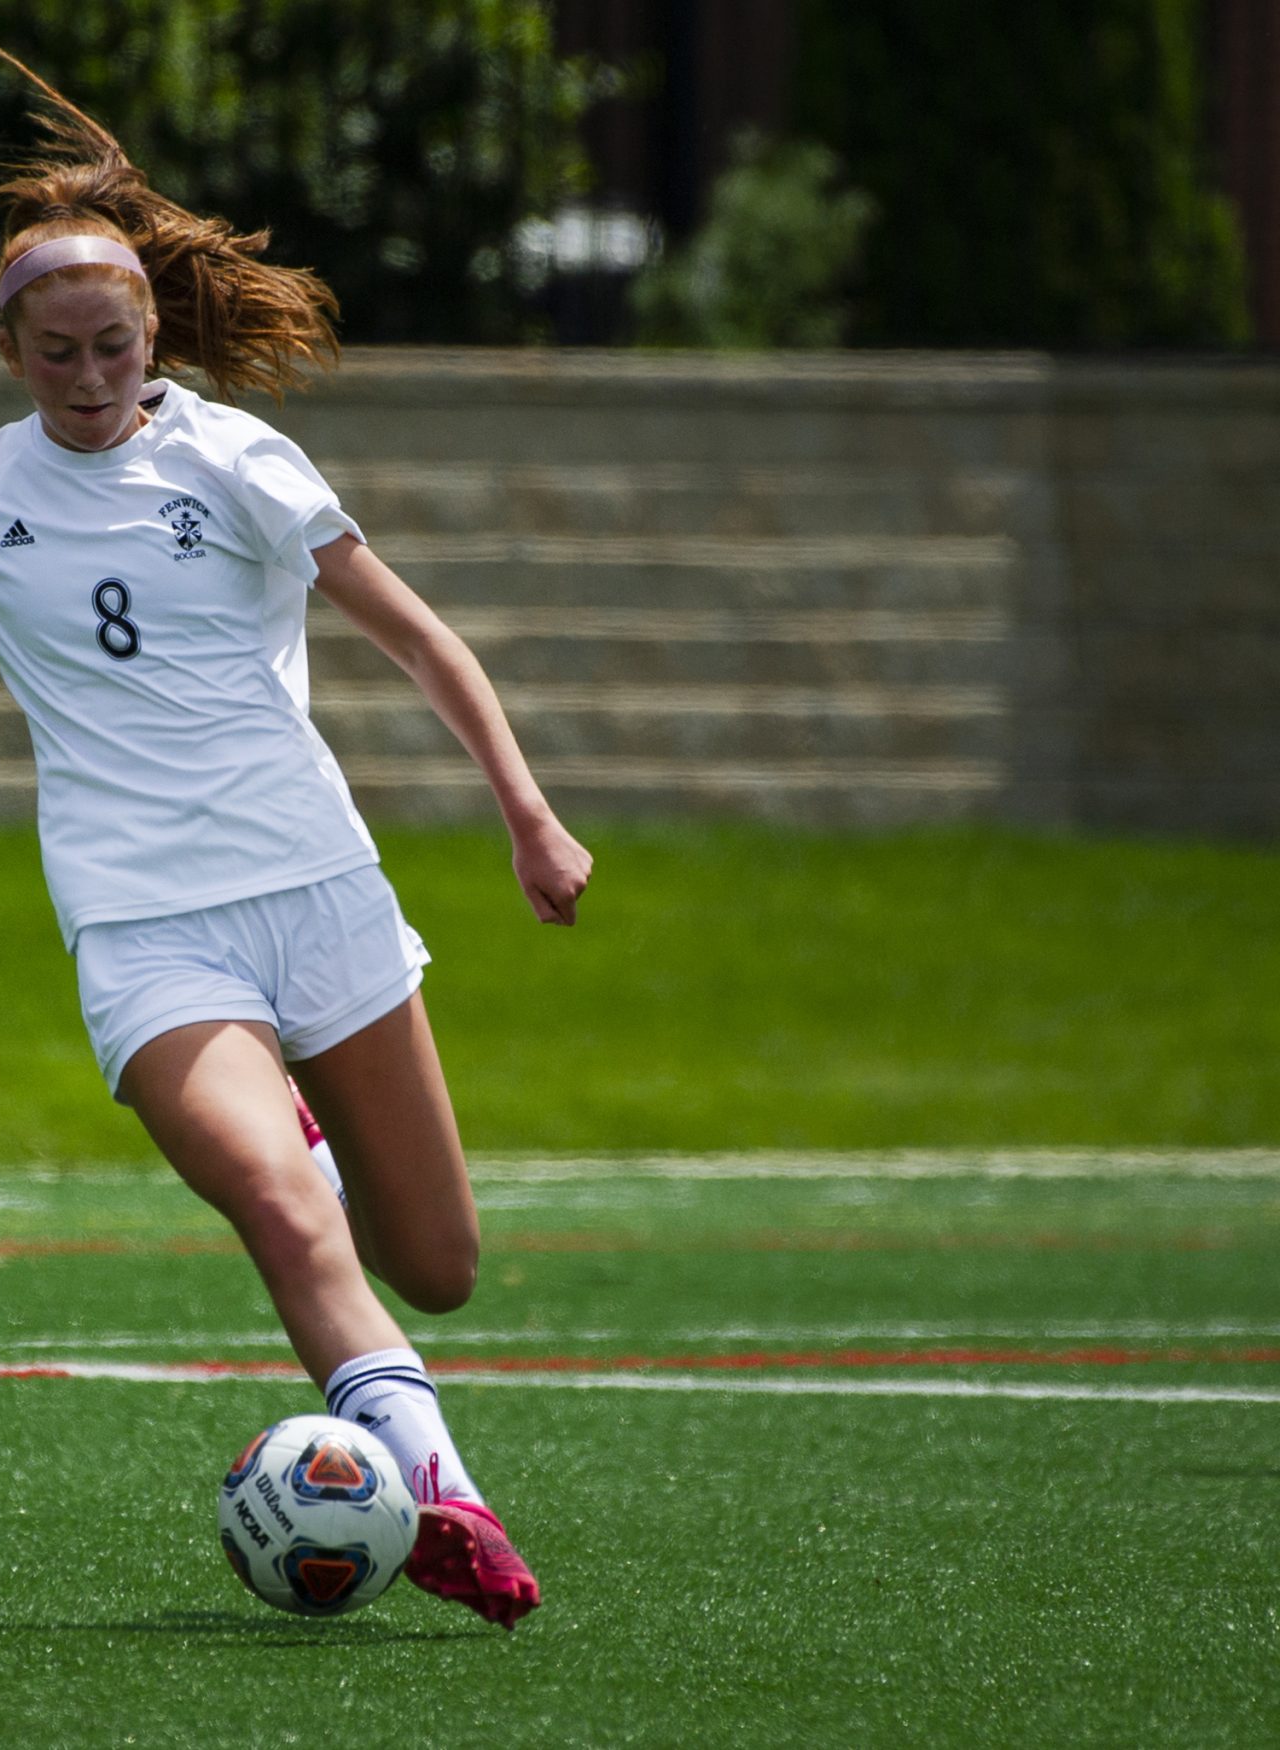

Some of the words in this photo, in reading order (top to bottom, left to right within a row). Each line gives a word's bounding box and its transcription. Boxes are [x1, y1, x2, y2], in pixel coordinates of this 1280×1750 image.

[158, 497, 210, 519] FENWICK
[0, 535, 35, 548] adidas
[174, 549, 206, 561] SOCCER
[91, 577, 142, 662] 8
[255, 1472, 294, 1535] Wilson
[234, 1498, 270, 1550] NCAA
